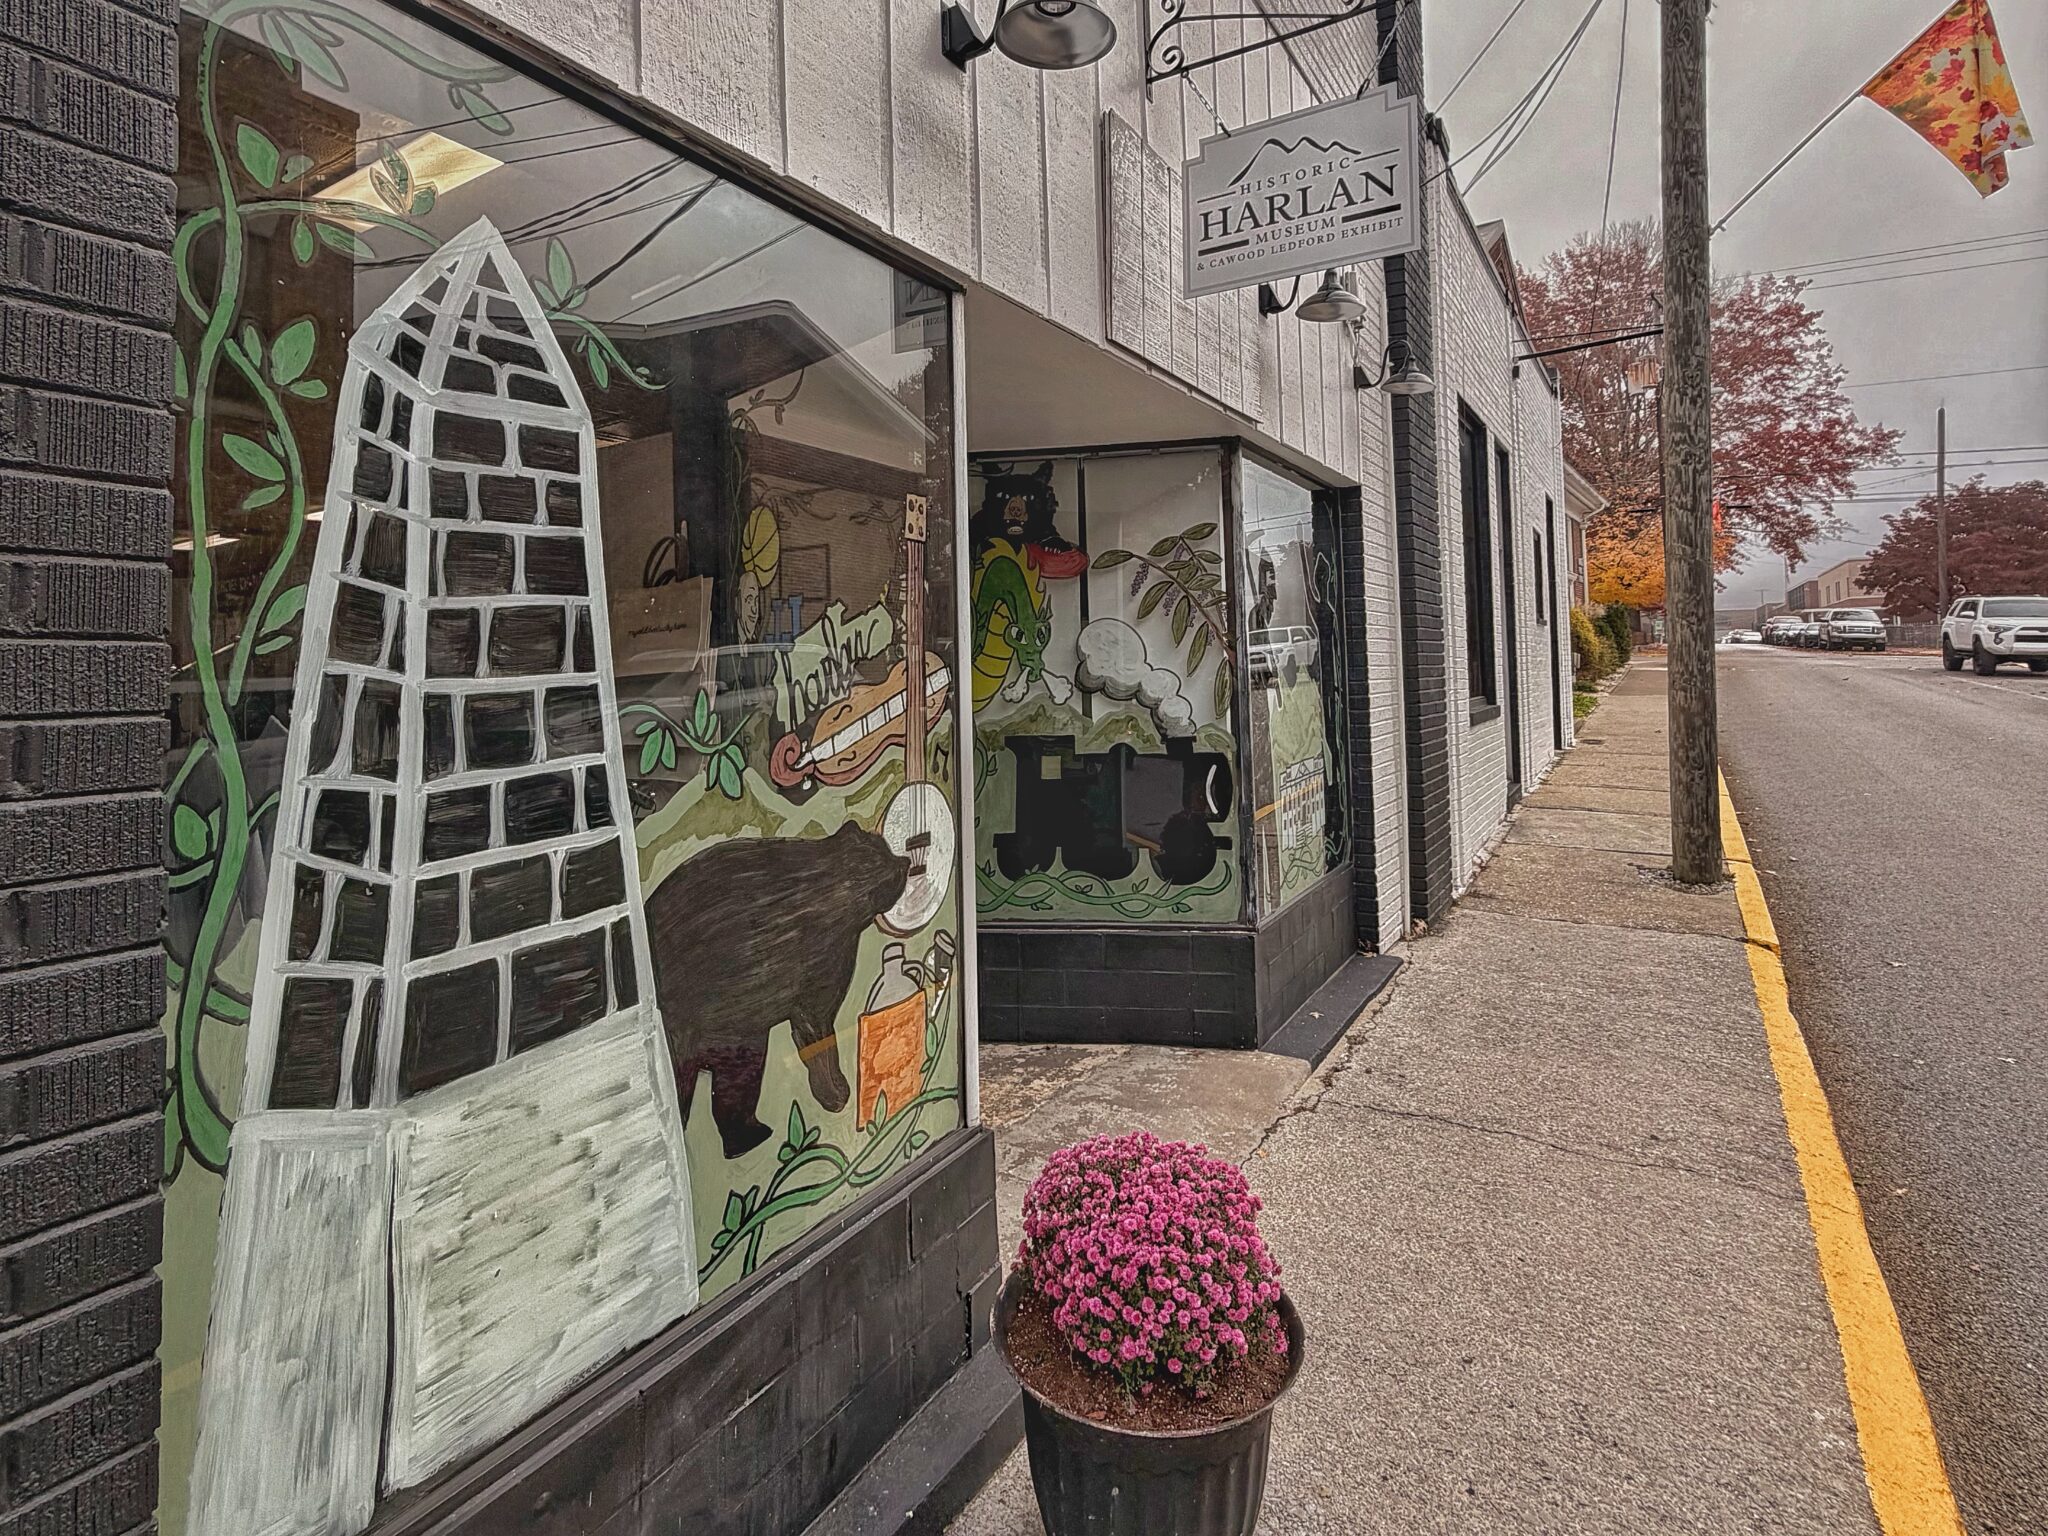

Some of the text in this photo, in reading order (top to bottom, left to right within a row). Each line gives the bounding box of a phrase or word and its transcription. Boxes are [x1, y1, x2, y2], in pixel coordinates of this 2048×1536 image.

[1239, 156, 1351, 196] HISTORIC
[1199, 163, 1399, 242] HARLAN
[1196, 216, 1404, 271] & CAWOOD LEDFORD EXHIBIT
[1255, 216, 1336, 245] MUSEUM
